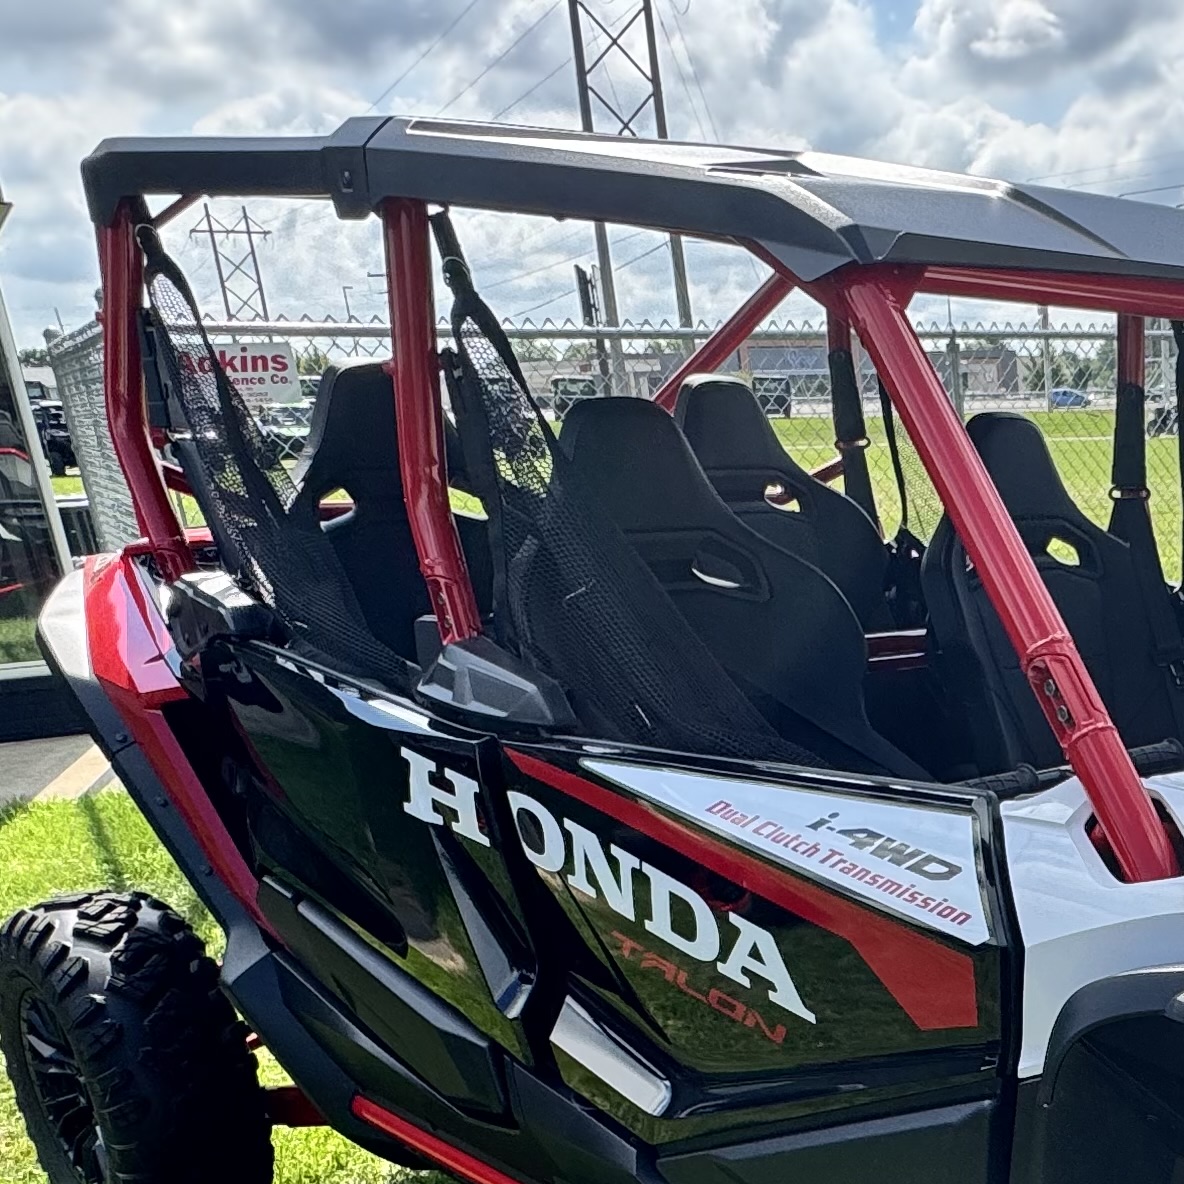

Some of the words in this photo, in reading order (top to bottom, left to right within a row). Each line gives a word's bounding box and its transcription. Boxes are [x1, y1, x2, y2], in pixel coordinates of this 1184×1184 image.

[270, 374, 293, 385] Co.
[400, 746, 817, 1025] HONDA
[705, 800, 760, 829] Dual
[752, 820, 820, 858] Clutch
[819, 848, 972, 926] Transmission
[806, 812, 962, 881] i-4WD
[611, 930, 787, 1044] TALON
